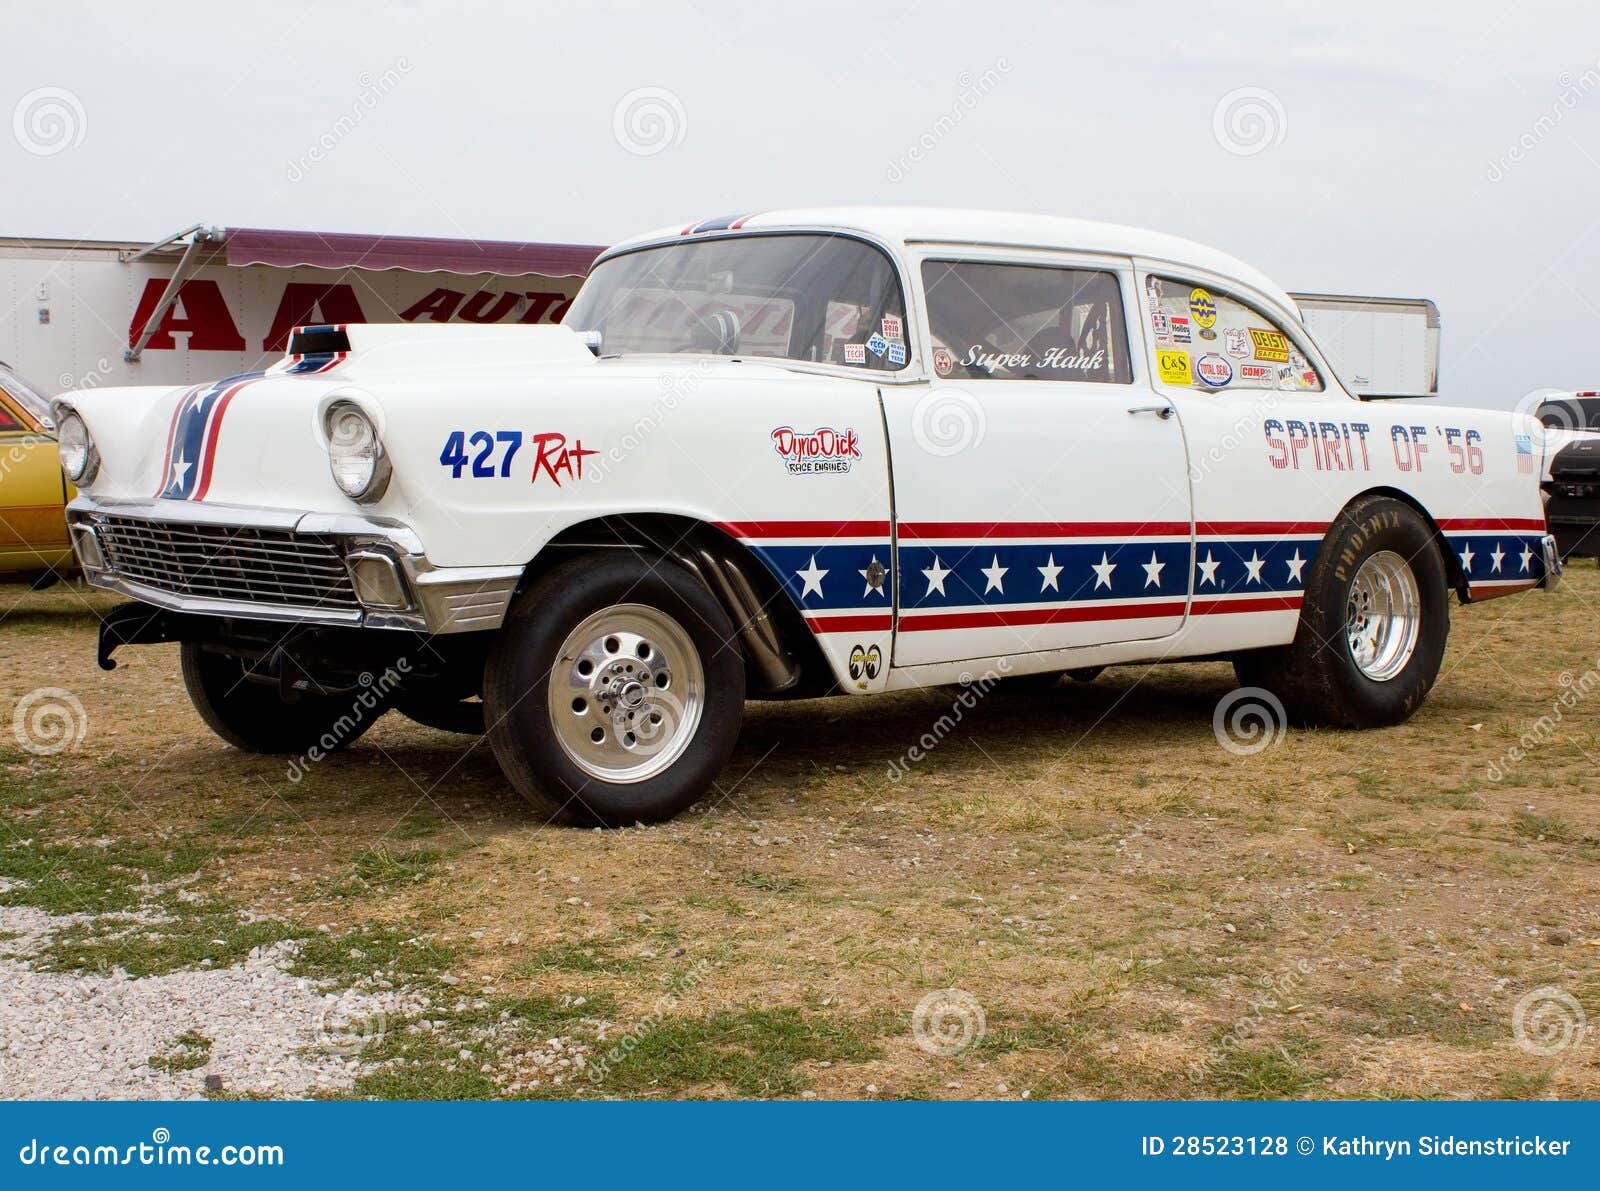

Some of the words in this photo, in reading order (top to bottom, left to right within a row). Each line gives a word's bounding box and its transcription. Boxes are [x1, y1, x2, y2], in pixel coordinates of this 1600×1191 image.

[1252, 331, 1285, 349] DEIST
[959, 344, 1031, 374] Super
[1036, 347, 1105, 370] Hank
[1161, 354, 1187, 371] C&S
[1257, 350, 1288, 360] SAFETY
[1200, 363, 1214, 375] TOTAL
[1215, 364, 1230, 377] SEAL
[1242, 366, 1265, 377] COMP
[1277, 366, 1294, 380] WIX
[440, 430, 523, 479] 427
[1264, 419, 1370, 471] SPIRIT
[1391, 425, 1430, 473] OF
[1435, 426, 1484, 476] '56
[789, 462, 813, 472] RACE
[814, 462, 848, 472] ENGINES
[1335, 511, 1401, 582] PHOENIX
